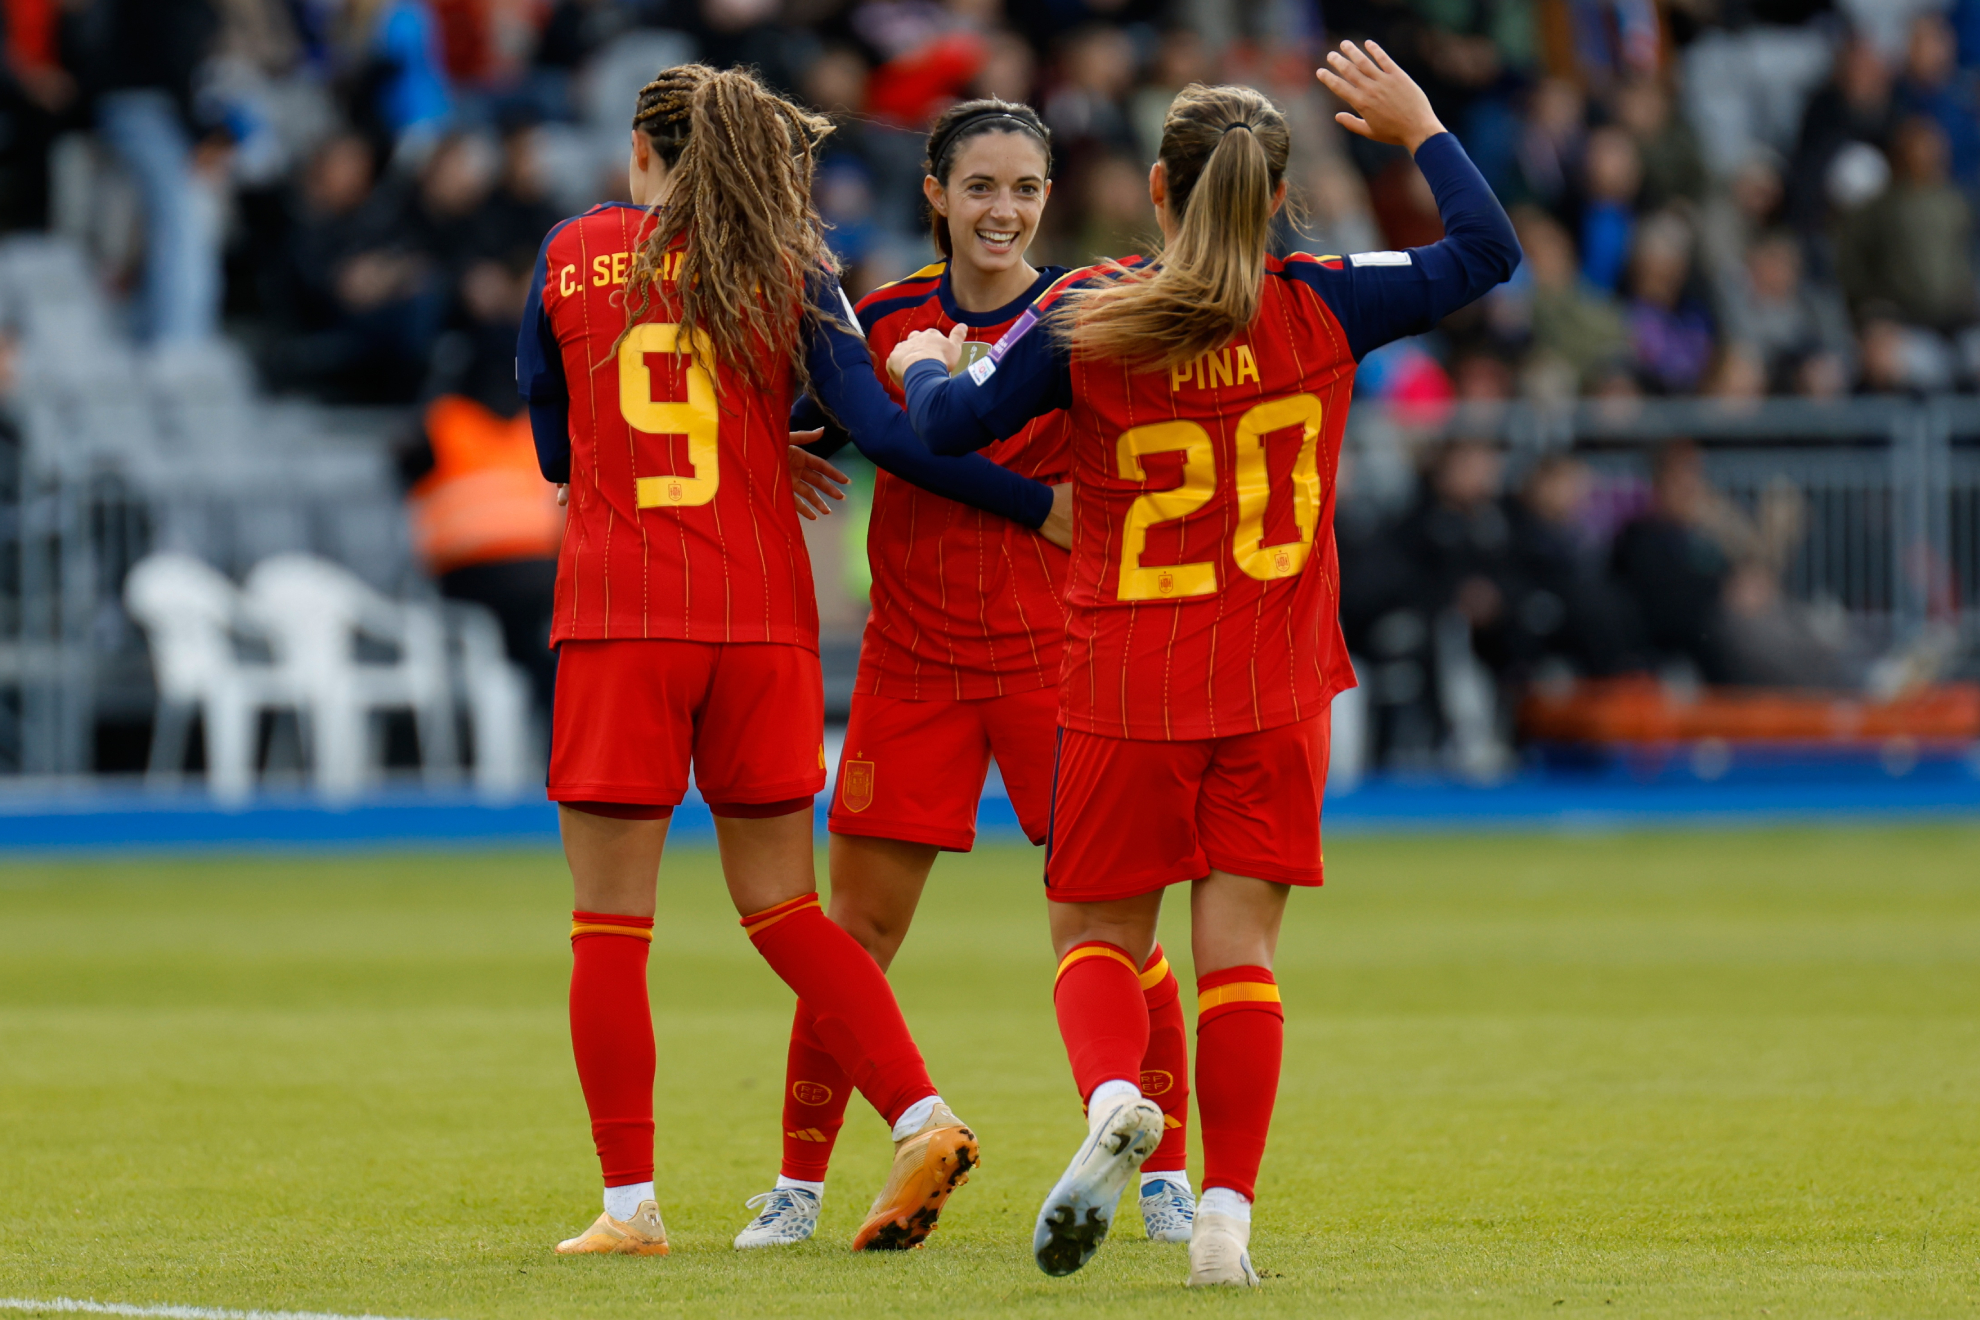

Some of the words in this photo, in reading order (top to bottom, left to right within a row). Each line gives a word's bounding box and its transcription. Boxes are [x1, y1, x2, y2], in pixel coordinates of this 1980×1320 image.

[560, 263, 583, 297] C.
[618, 322, 719, 509] 9
[1171, 344, 1261, 392] PINA
[1116, 392, 1322, 601] 20
